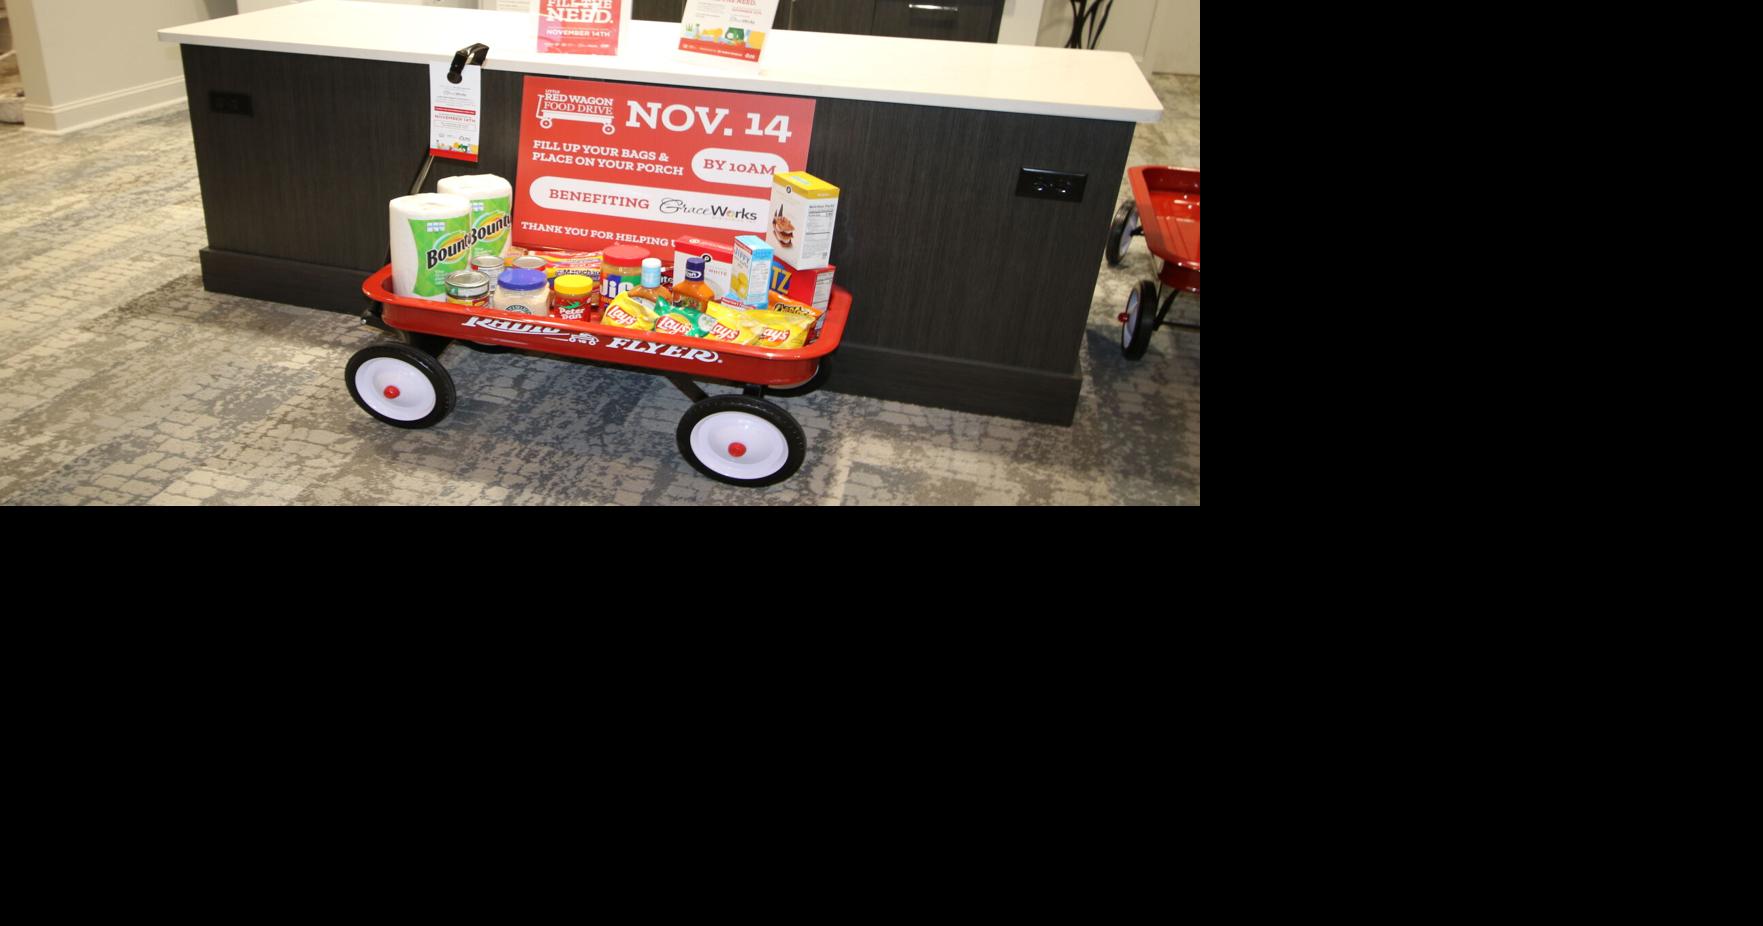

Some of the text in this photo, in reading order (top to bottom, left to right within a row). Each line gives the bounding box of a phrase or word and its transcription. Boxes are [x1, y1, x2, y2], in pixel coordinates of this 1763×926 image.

[546, 29, 590, 37] NOVEMBER
[543, 101, 613, 115] FOOD DRIVE
[544, 93, 614, 106] RED WAGON
[625, 100, 792, 143] NOV. 14
[533, 140, 669, 162] FILL UP YOUR BAGS &
[532, 152, 684, 176] PLACE ON YOUR PORCH
[703, 159, 777, 175] BY 10AM
[549, 189, 650, 209] BENEFITING
[660, 197, 757, 220] GraceWorks
[521, 221, 563, 234] THANK
[564, 227, 589, 237] YOU
[590, 230, 614, 240] FOR
[615, 232, 669, 246] HELPING
[558, 306, 585, 316] Peter
